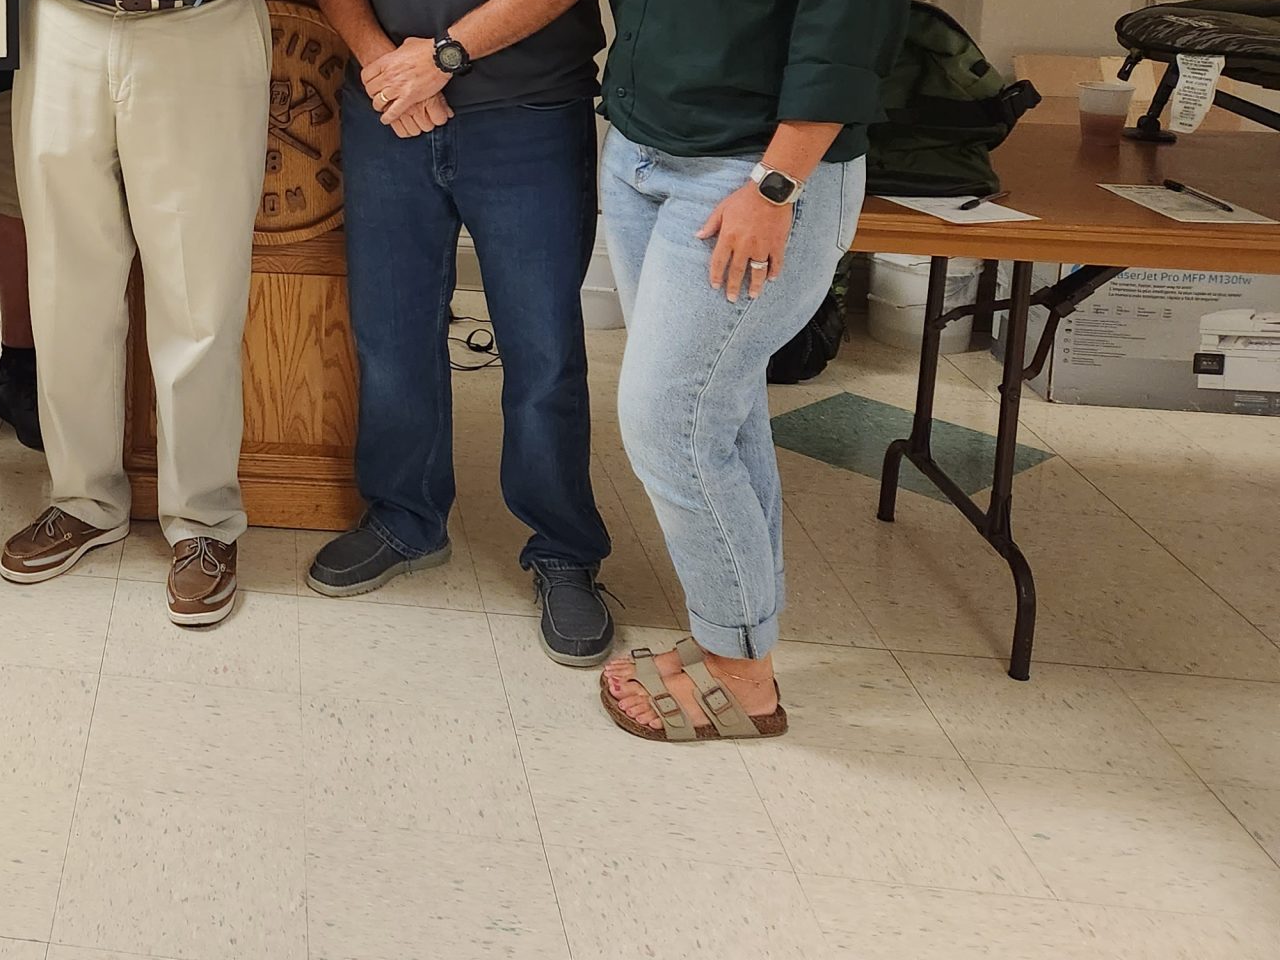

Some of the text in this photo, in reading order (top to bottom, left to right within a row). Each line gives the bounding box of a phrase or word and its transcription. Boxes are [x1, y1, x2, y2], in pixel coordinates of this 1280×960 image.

[1116, 271, 1252, 285] aserJet Pro MFP M130fw
